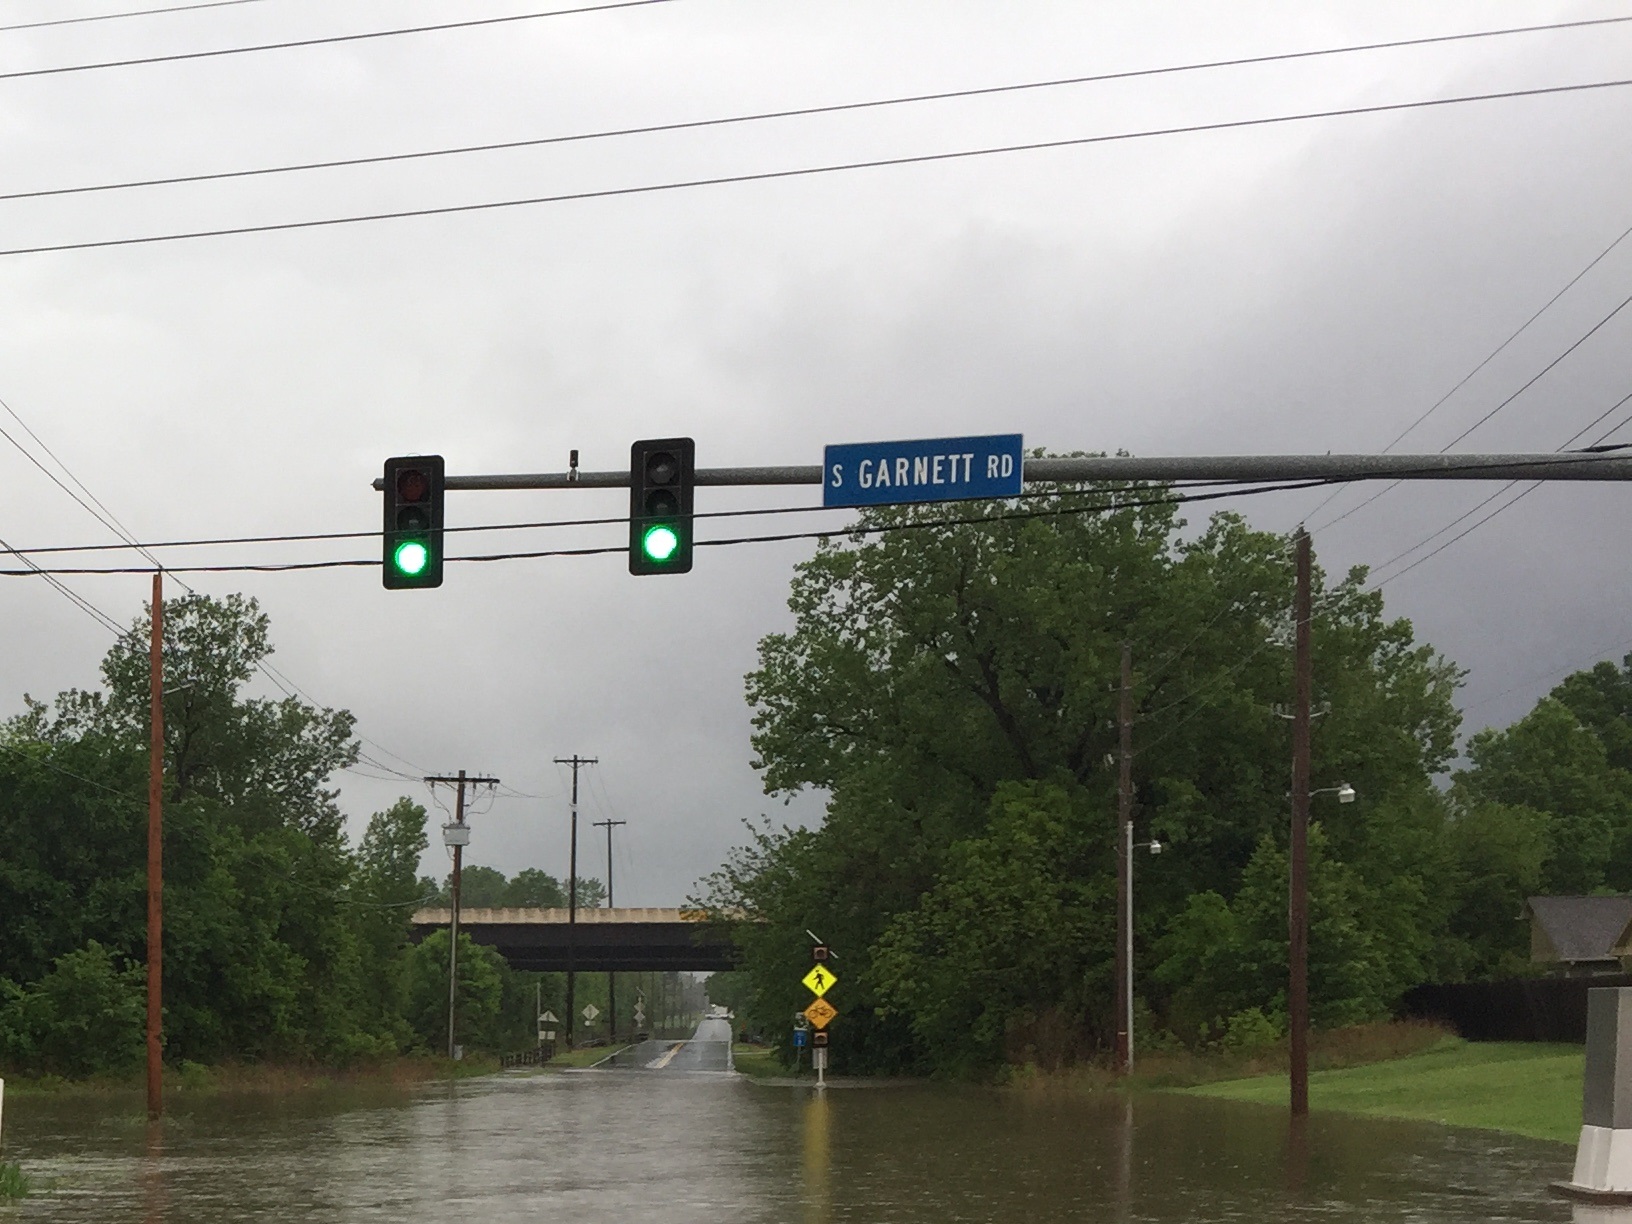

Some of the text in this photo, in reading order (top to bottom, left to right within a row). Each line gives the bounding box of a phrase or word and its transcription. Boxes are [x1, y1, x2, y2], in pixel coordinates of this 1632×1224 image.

[831, 453, 1013, 489] S GARNETT RD
